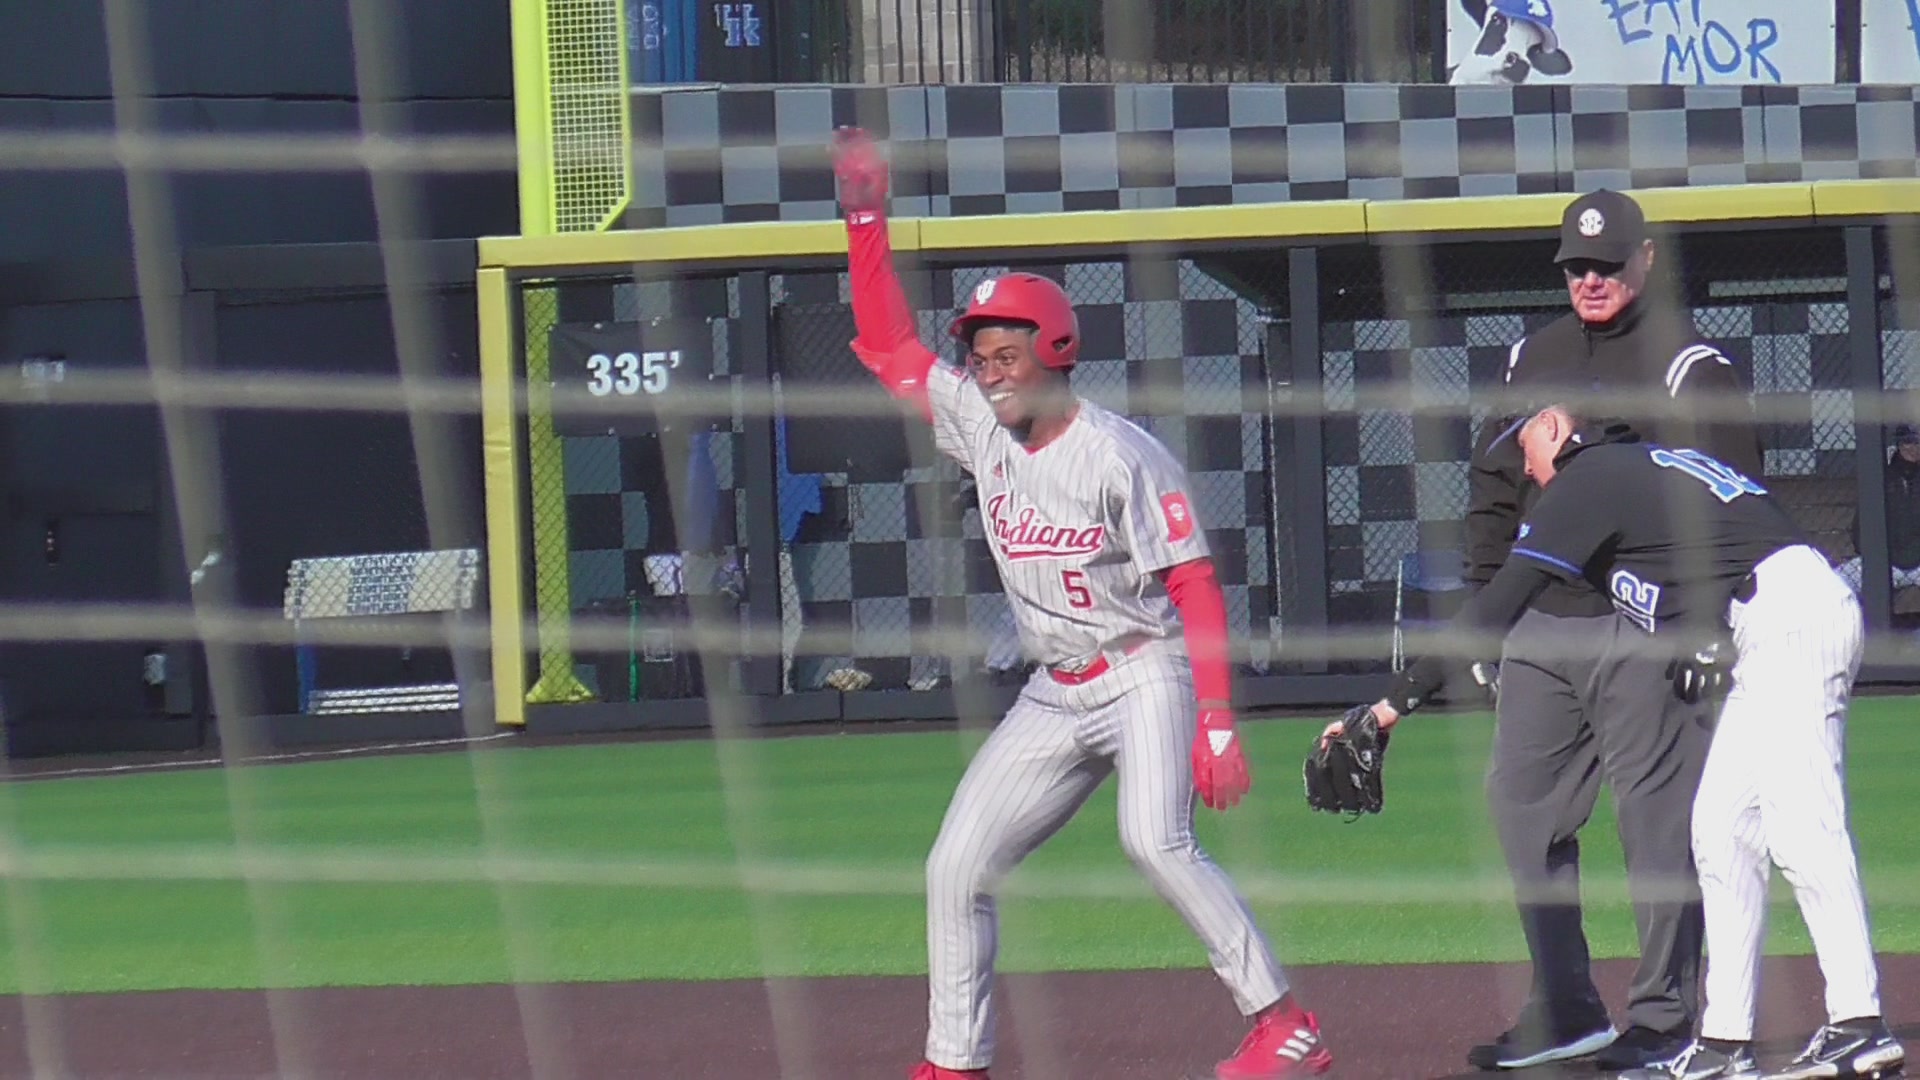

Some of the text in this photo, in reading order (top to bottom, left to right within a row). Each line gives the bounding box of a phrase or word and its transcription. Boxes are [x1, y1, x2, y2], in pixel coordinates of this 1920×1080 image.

[1661, 18, 1781, 84] MOR
[986, 492, 1105, 556] Indiana
[1062, 569, 1092, 609] 5
